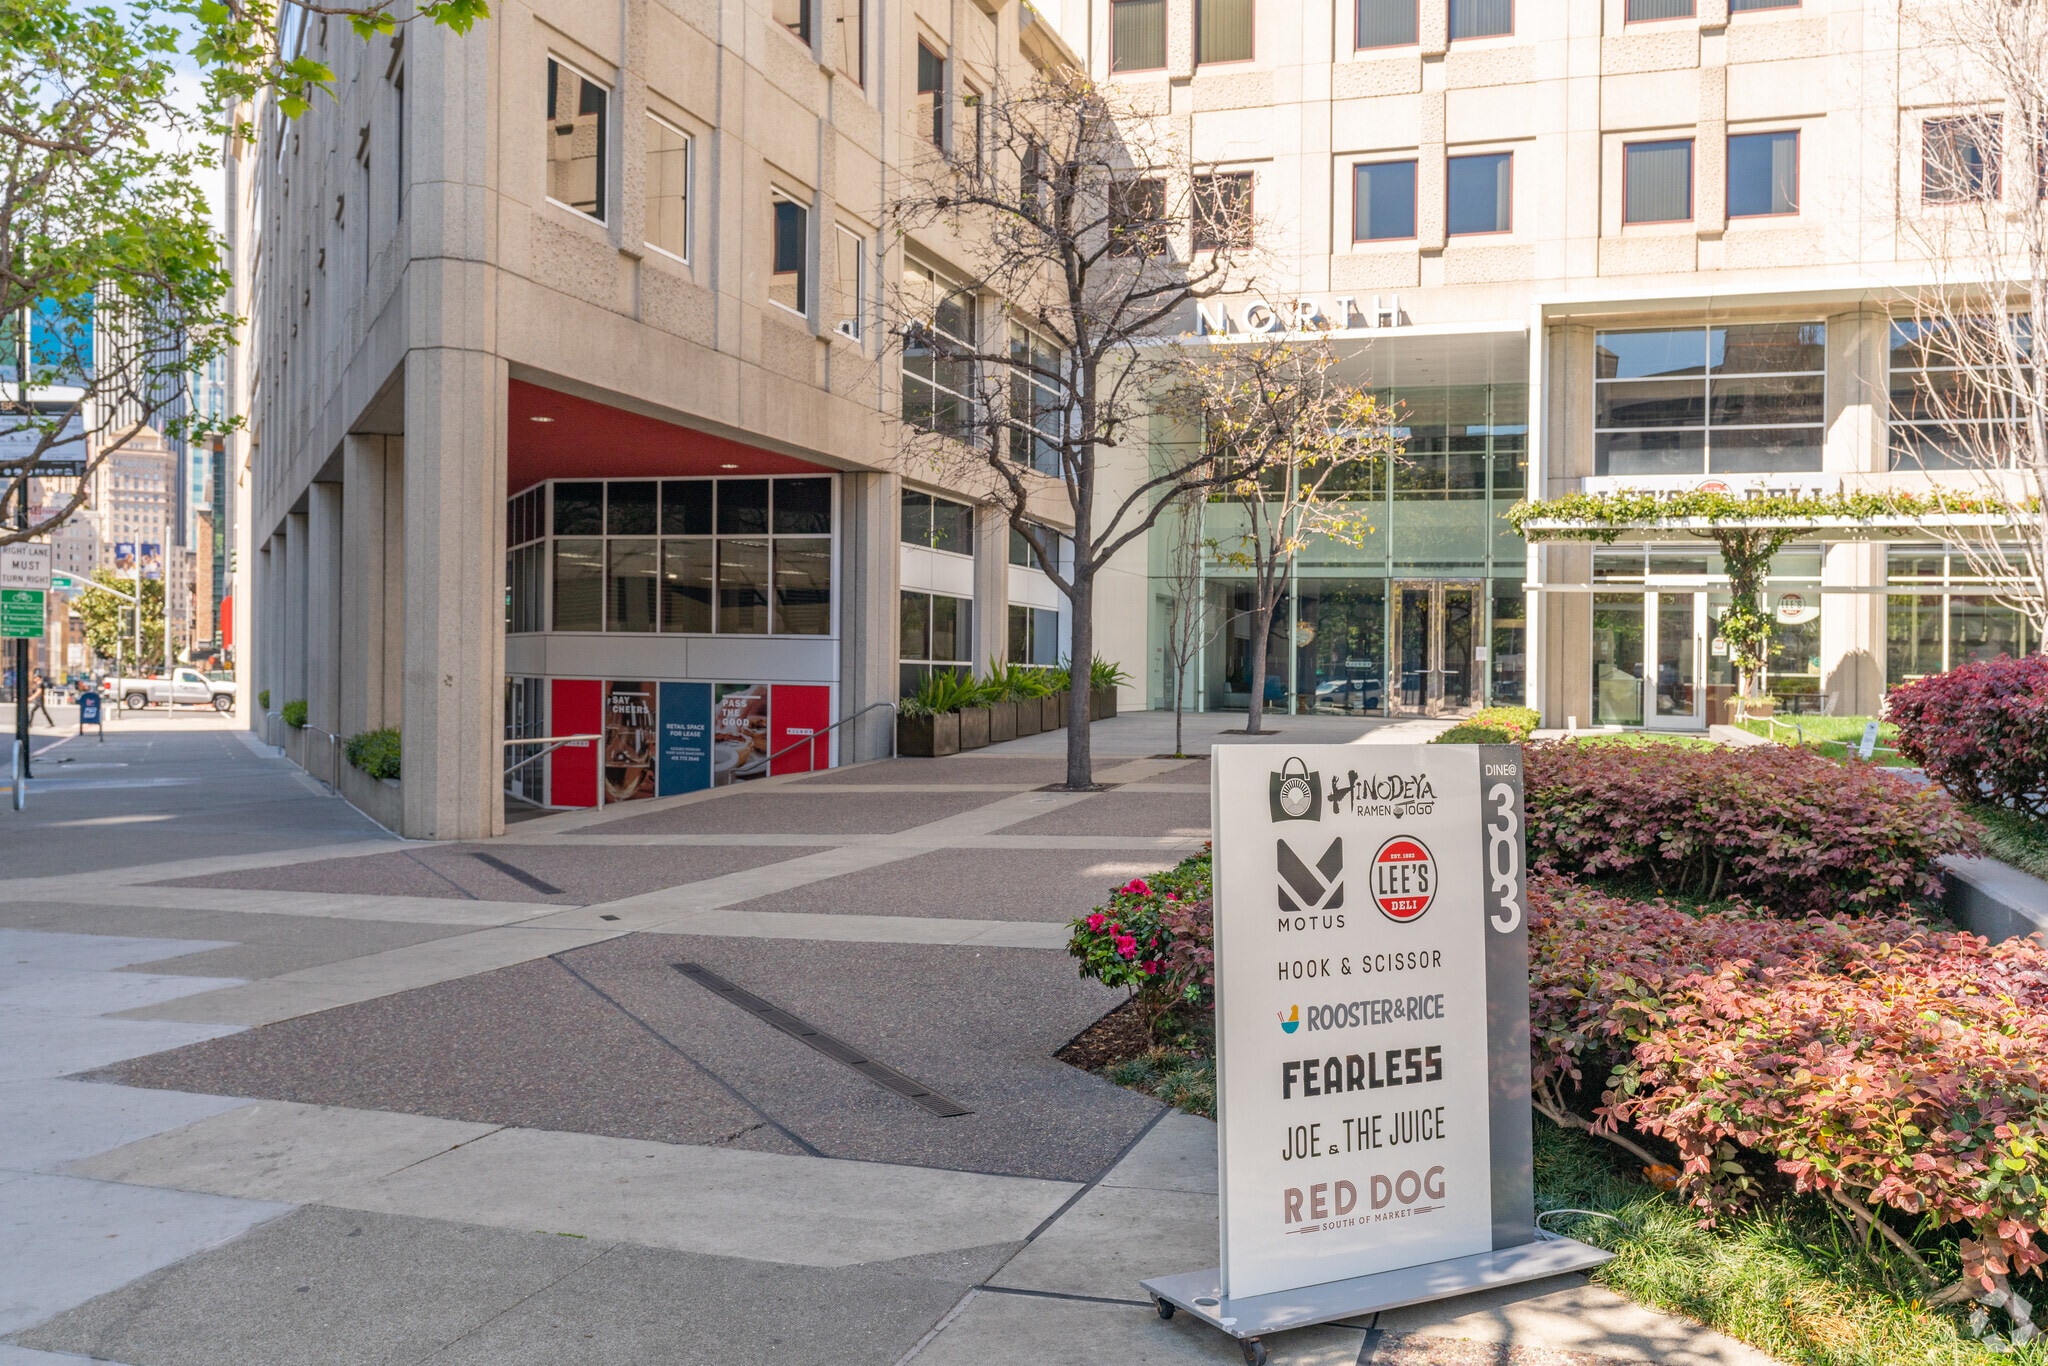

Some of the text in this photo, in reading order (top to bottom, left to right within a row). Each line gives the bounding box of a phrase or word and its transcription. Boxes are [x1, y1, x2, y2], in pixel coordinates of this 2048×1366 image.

[1196, 294, 1399, 335] NORTH
[3, 546, 48, 557] RIGHT LANE
[12, 560, 40, 570] MUST
[3, 574, 23, 582] TURN
[27, 575, 49, 583] RIGHT
[612, 696, 630, 704] SAY
[722, 700, 747, 708] PASS
[612, 705, 649, 714] CHEERS
[722, 708, 741, 717] THE
[722, 718, 750, 727] GOOD
[1485, 764, 1517, 776] DINE@
[1357, 805, 1391, 817] RAMEN
[1378, 863, 1429, 895] LEE'S
[1391, 899, 1417, 911] DELI
[1278, 914, 1345, 932] MOTUS
[1278, 950, 1441, 980] HOOK & SCISSOR
[1282, 1045, 1443, 1100] FEARLESS
[1282, 1106, 1446, 1161] JOE & THE JUICE
[1284, 1165, 1446, 1225] RED DOG
[1322, 1208, 1412, 1231] SOUTH OF MARKET
